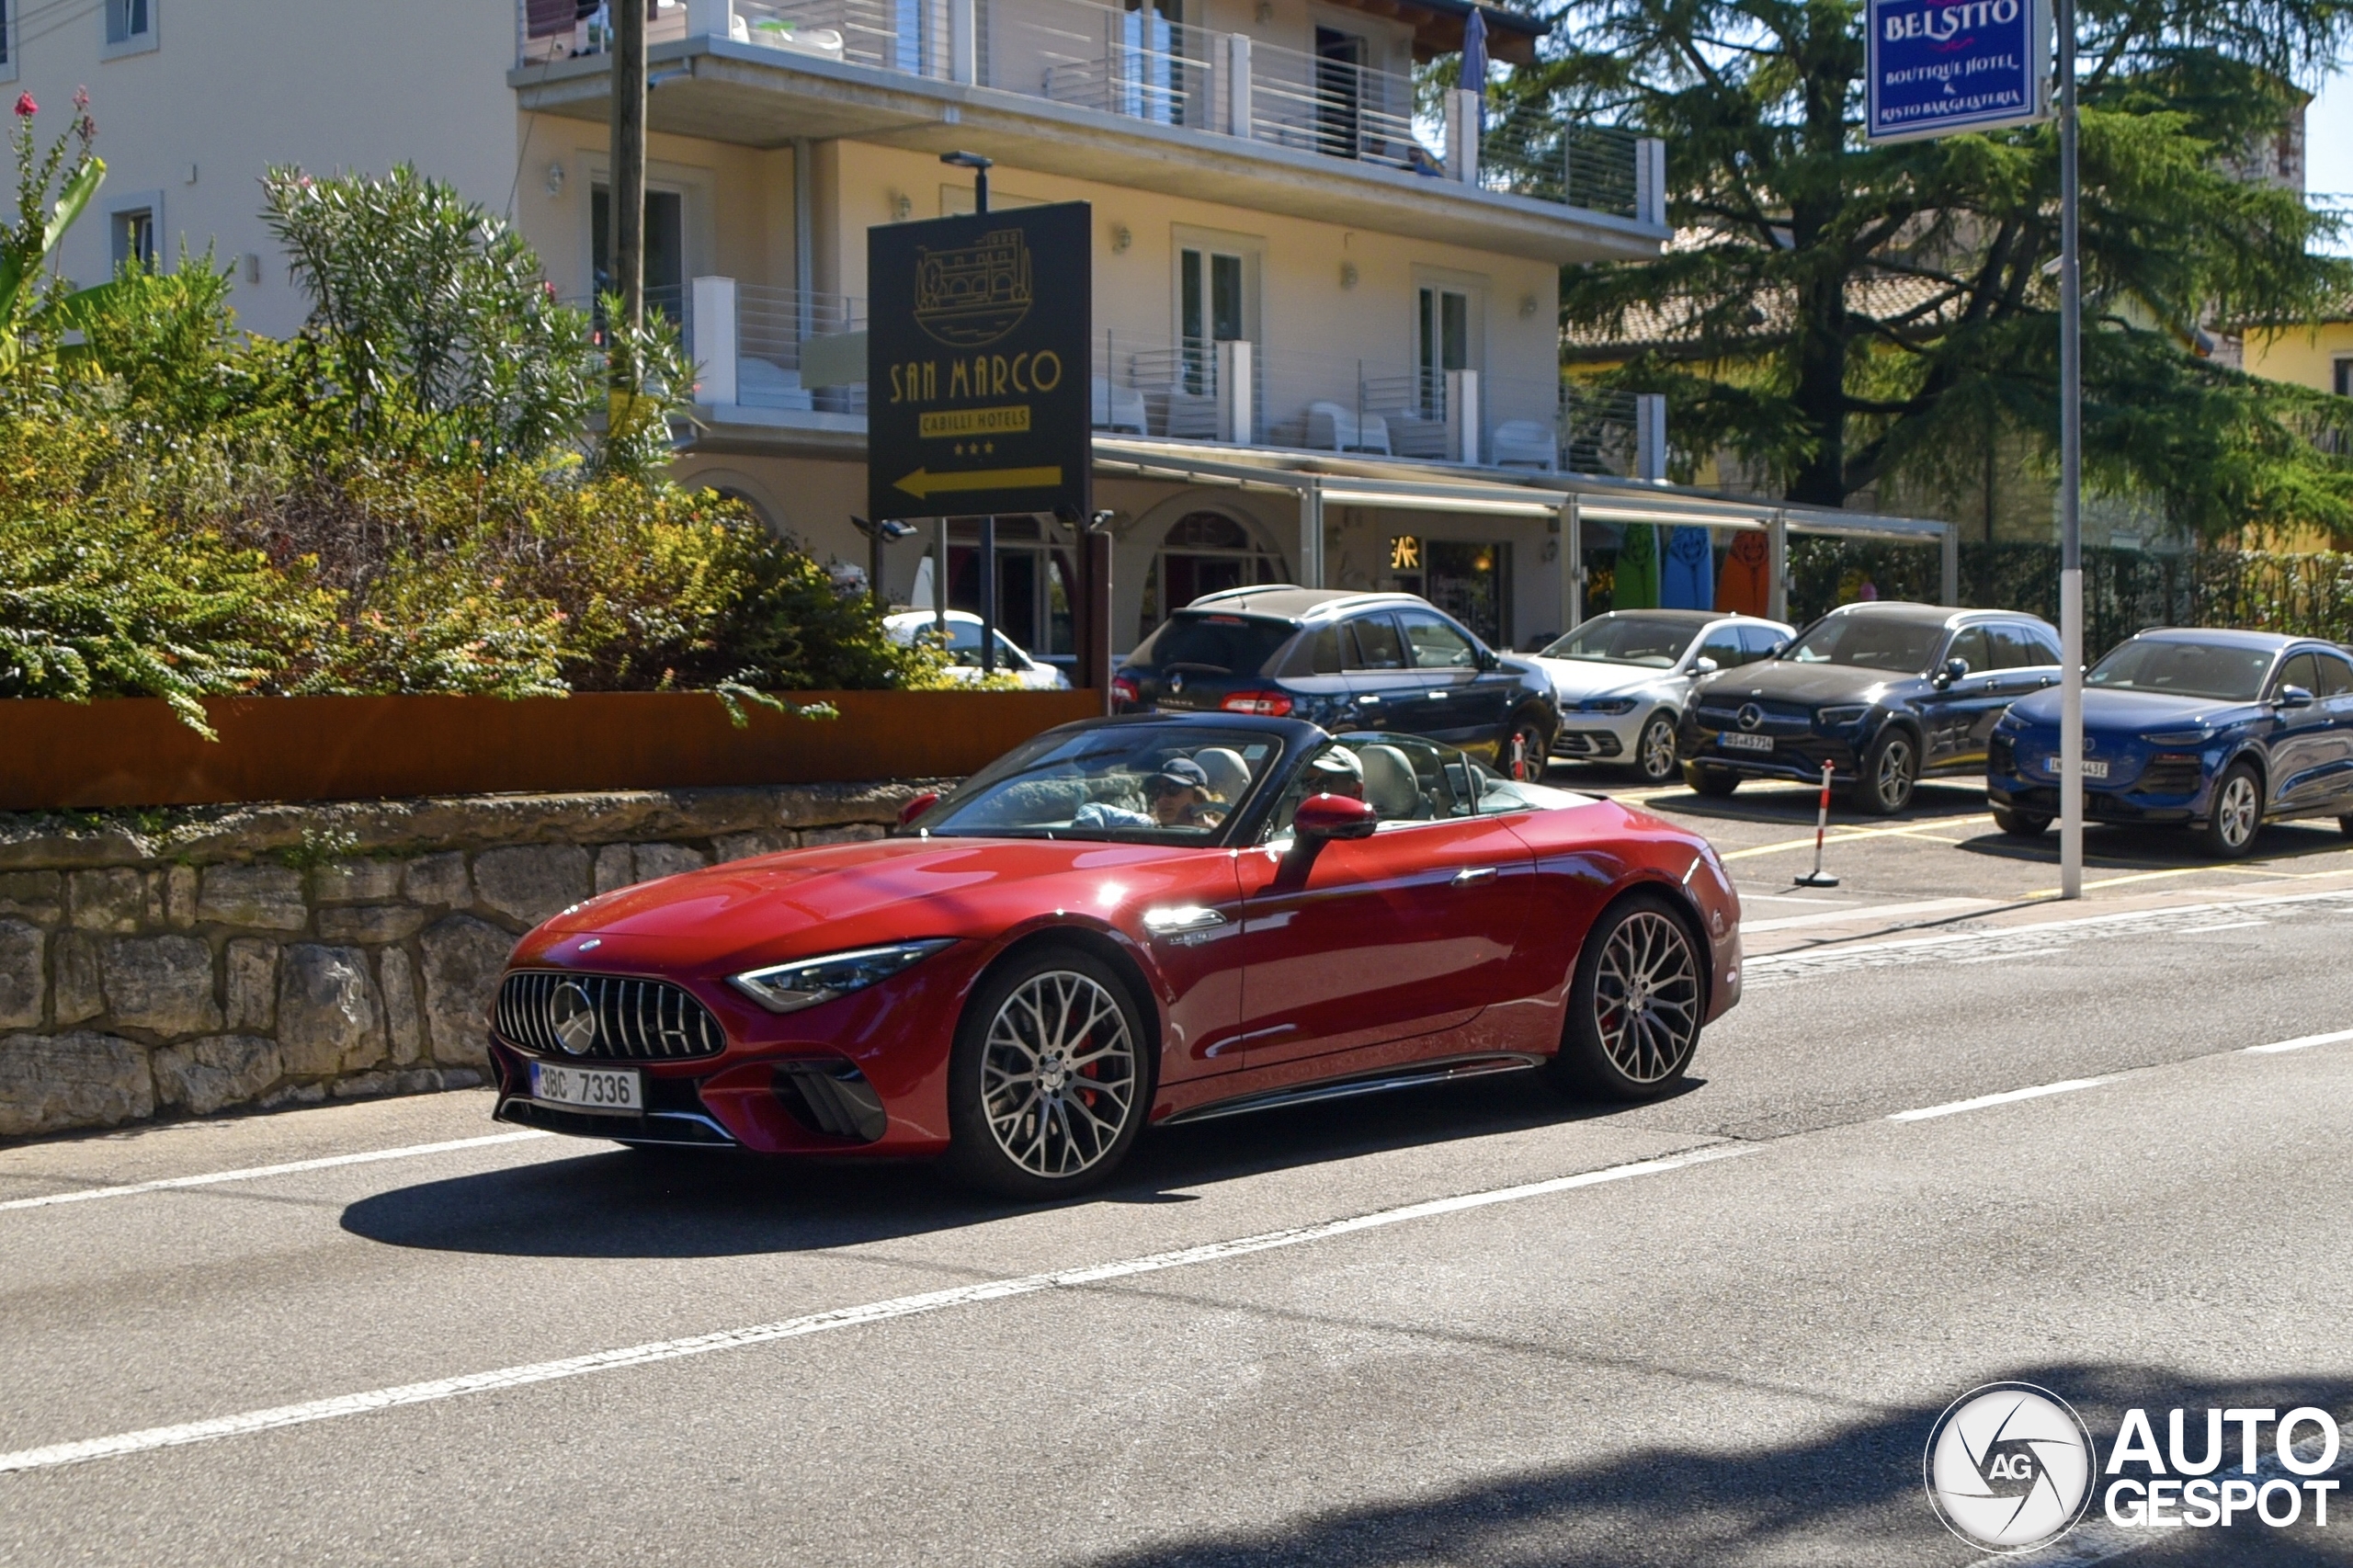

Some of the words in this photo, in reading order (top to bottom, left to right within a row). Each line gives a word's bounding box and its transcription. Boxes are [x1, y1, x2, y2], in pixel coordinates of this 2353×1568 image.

[1884, 0, 2018, 41] BELSITO
[1885, 60, 1962, 85] BOUTIQUE
[1965, 53, 2020, 76] HOTEL
[1943, 82, 1957, 95] &
[1881, 104, 1920, 121] RISTO
[890, 359, 936, 403] SAN
[949, 349, 1062, 399] MARCO
[922, 414, 973, 432] CABILLI
[978, 410, 1027, 427] HOTELS
[541, 1068, 567, 1099] 3BC
[579, 1073, 631, 1104] 7336
